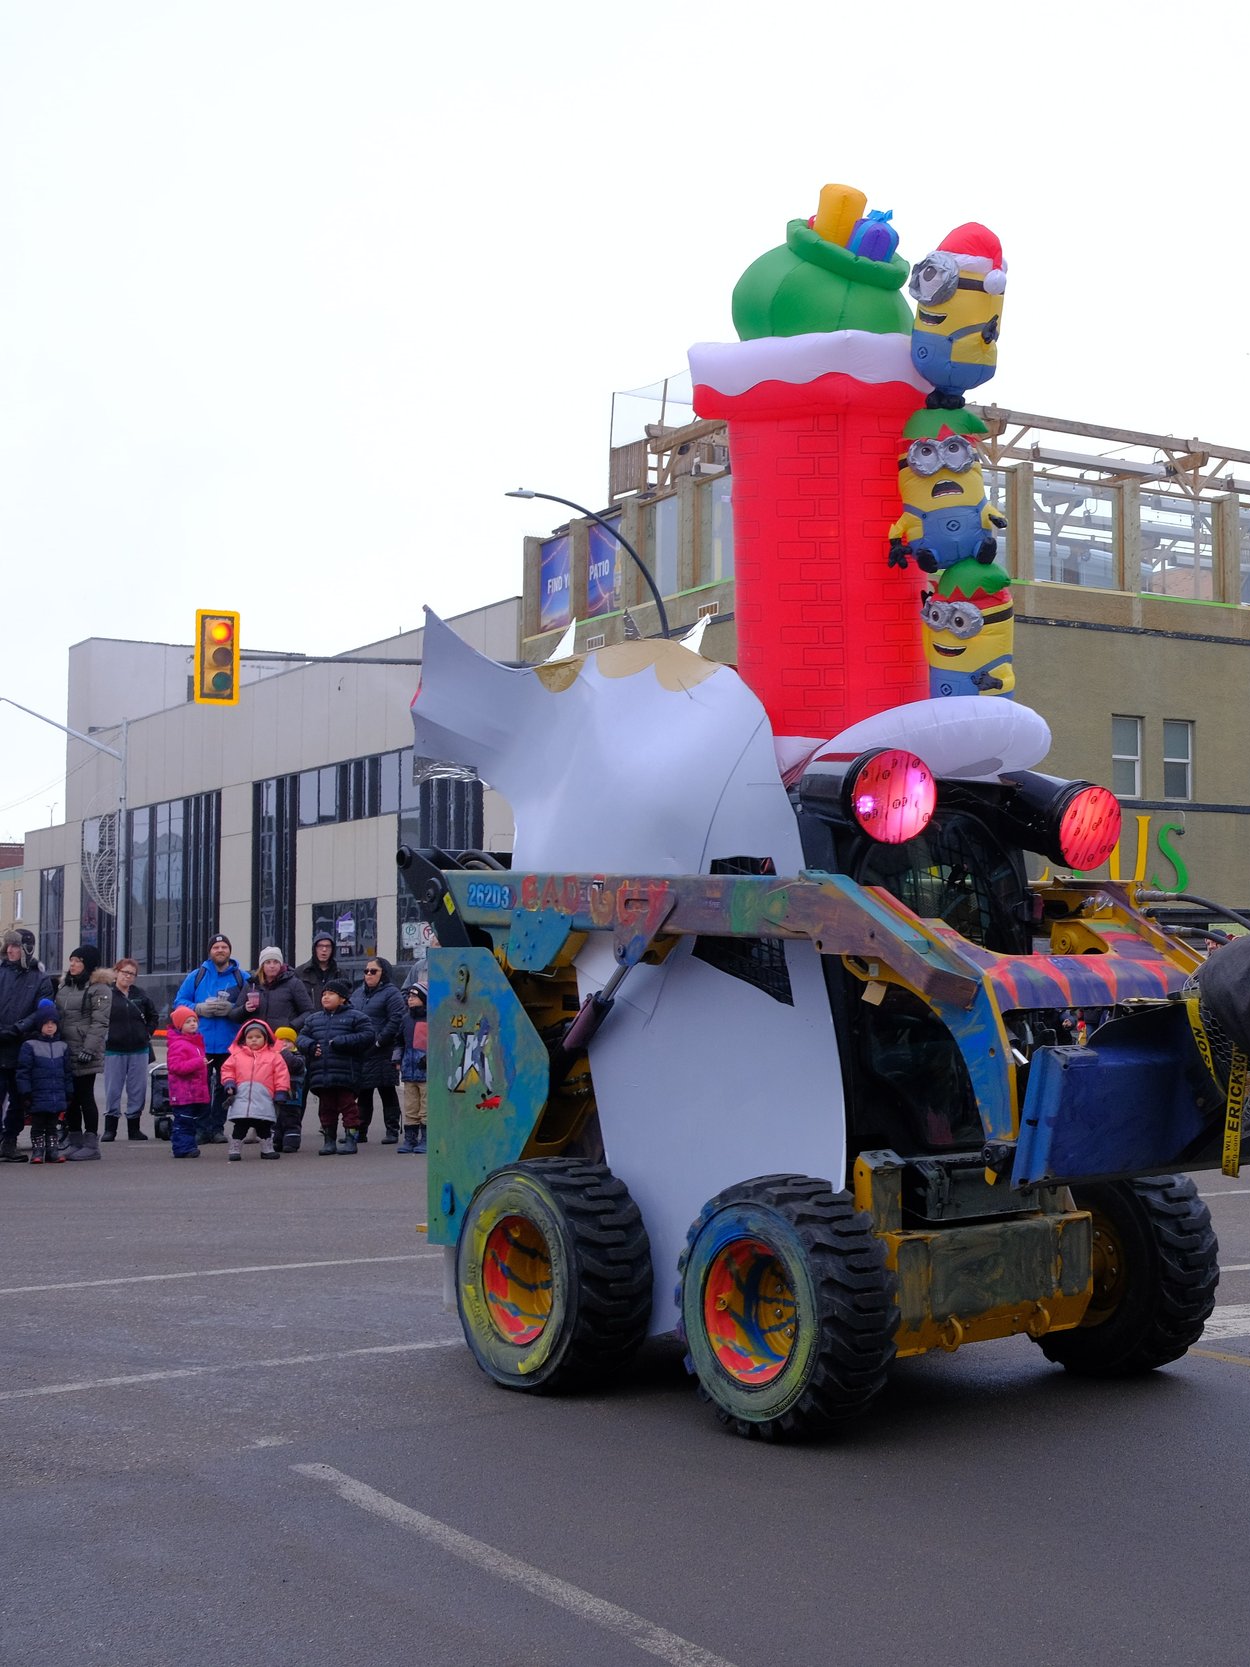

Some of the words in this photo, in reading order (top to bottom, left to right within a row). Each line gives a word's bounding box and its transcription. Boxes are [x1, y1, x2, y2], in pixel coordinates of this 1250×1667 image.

[589, 559, 610, 581] PATIO
[547, 575, 563, 595] FIND
[468, 883, 510, 908] 262D3
[1227, 1053, 1247, 1132] ERICKSO
